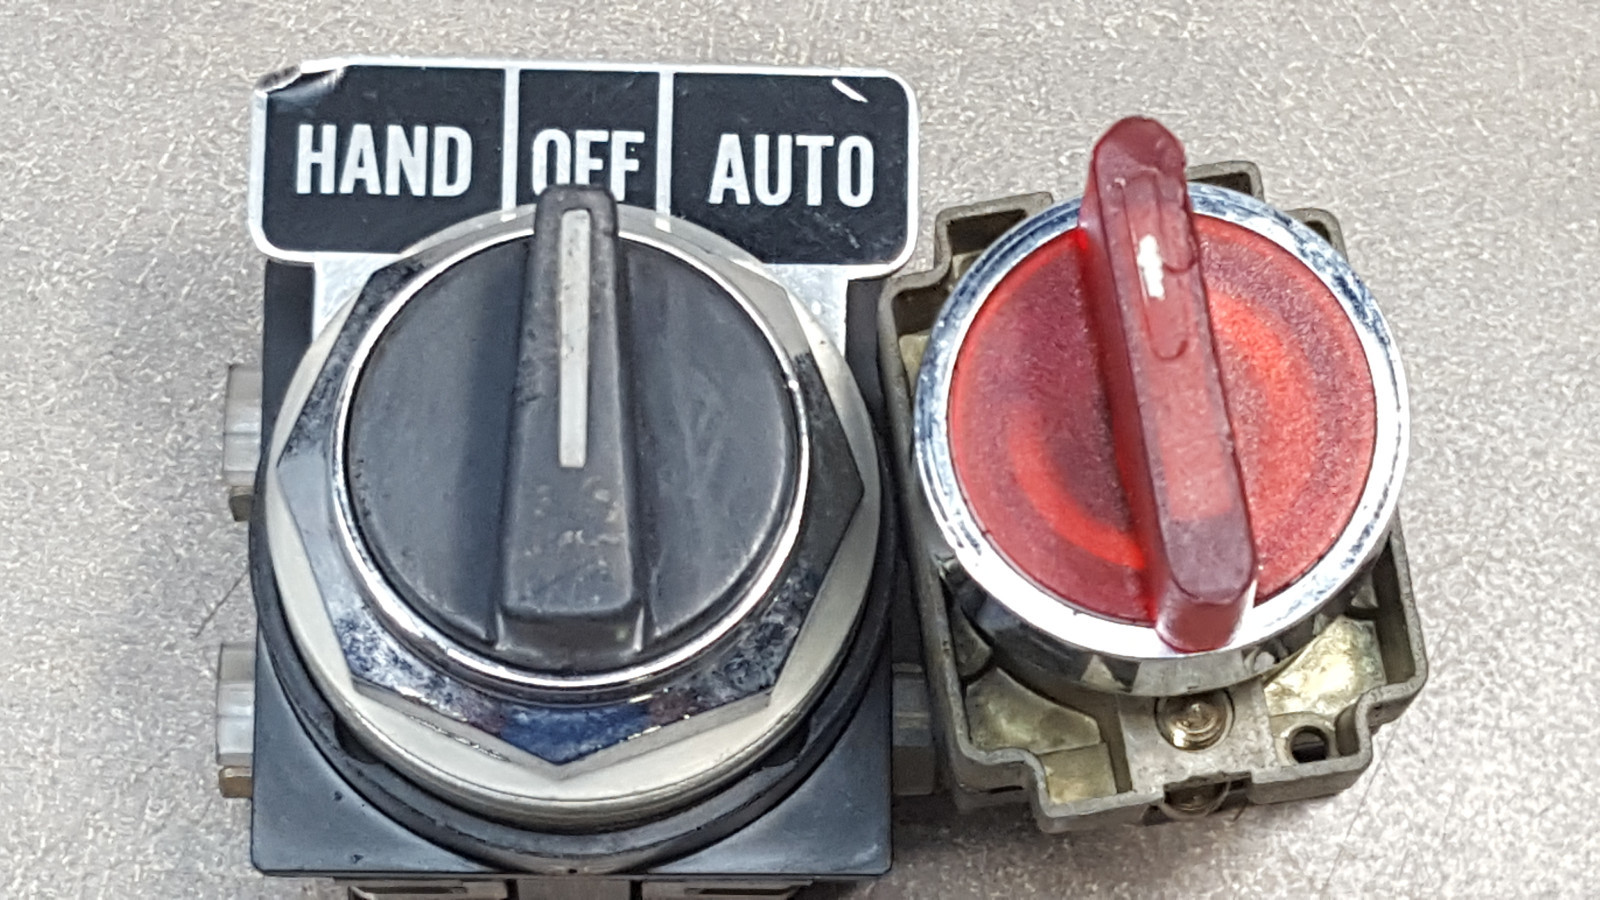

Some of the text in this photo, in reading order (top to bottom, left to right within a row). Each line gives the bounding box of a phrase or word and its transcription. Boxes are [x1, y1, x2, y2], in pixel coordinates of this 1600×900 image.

[295, 123, 473, 197] HAND
[531, 128, 646, 202] OFF
[707, 133, 875, 208] AUTO
